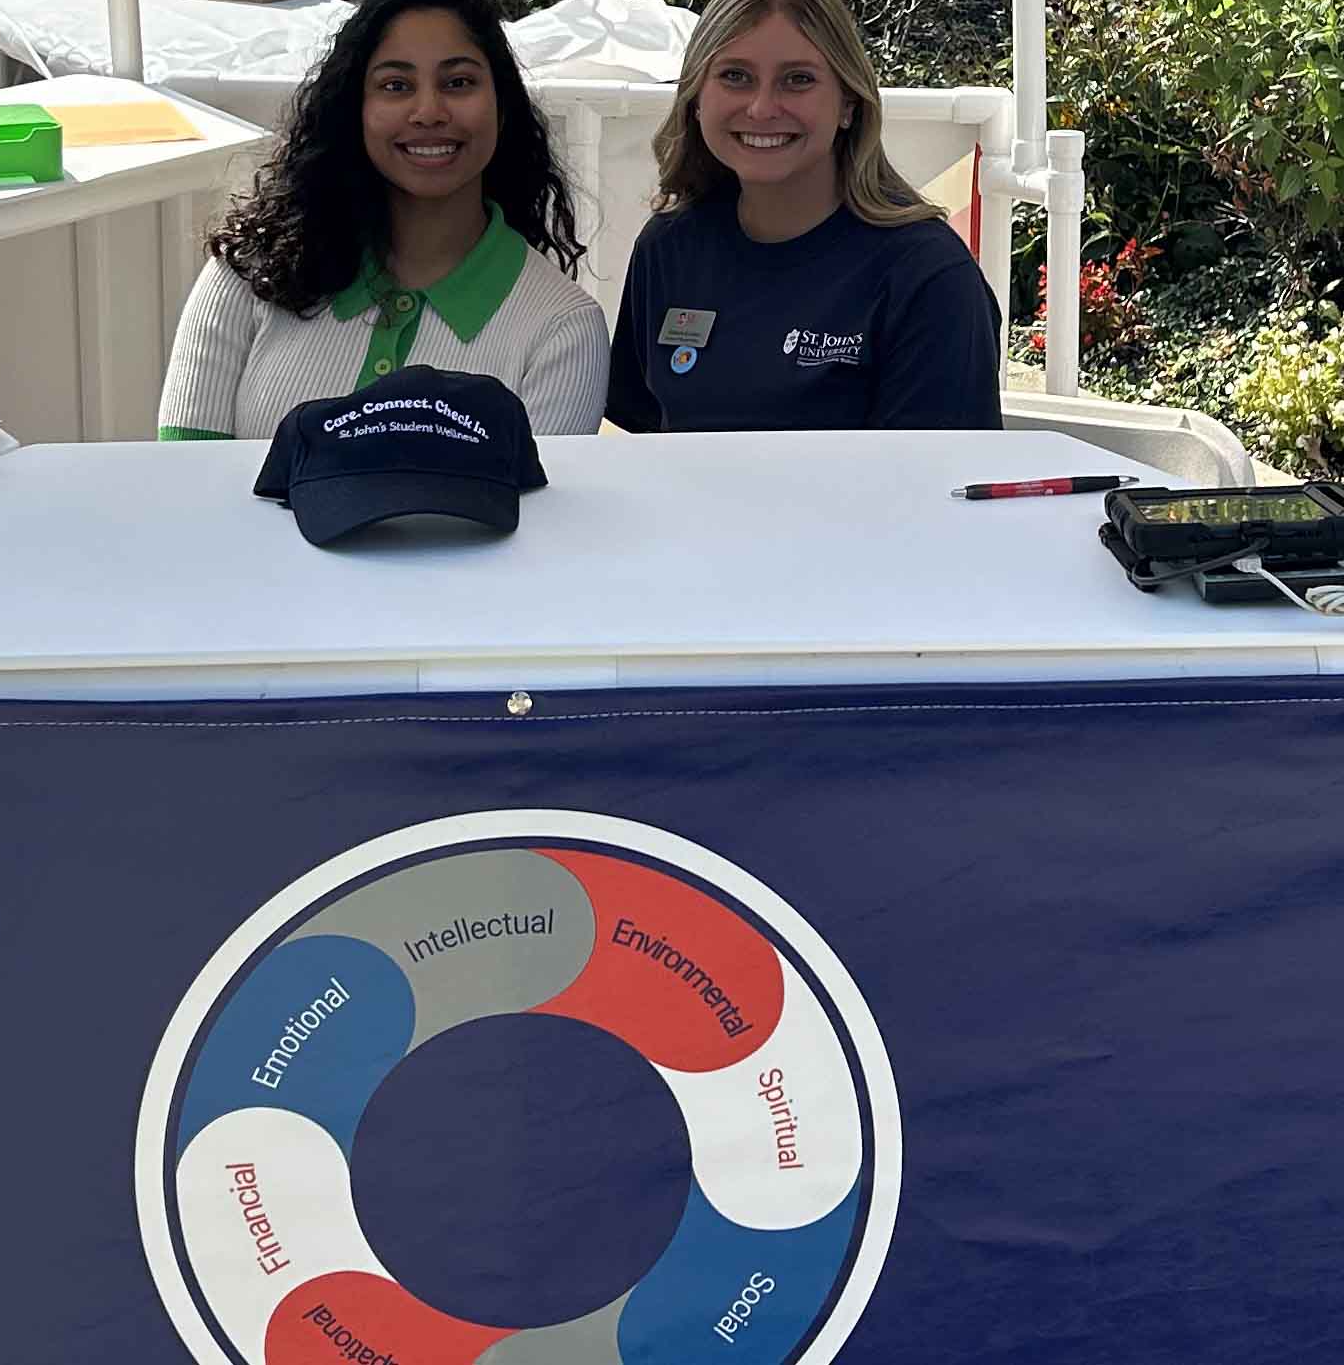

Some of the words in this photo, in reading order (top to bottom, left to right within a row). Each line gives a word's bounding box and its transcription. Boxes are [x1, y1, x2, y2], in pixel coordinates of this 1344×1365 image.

[799, 345, 862, 358] UNIVERSITY
[323, 409, 362, 433] Care.
[362, 398, 433, 415] Connect.
[434, 399, 473, 430] Check
[354, 421, 387, 438] John's
[389, 421, 433, 433] Student
[435, 423, 480, 443] Wellness
[403, 908, 556, 965] Intellectual
[611, 918, 754, 1040] Environmental
[251, 977, 352, 1090] Emotional
[757, 1067, 805, 1172] Spiritual
[225, 1161, 292, 1277] Financial
[301, 1302, 401, 1365] pational
[713, 1271, 776, 1345] Social
